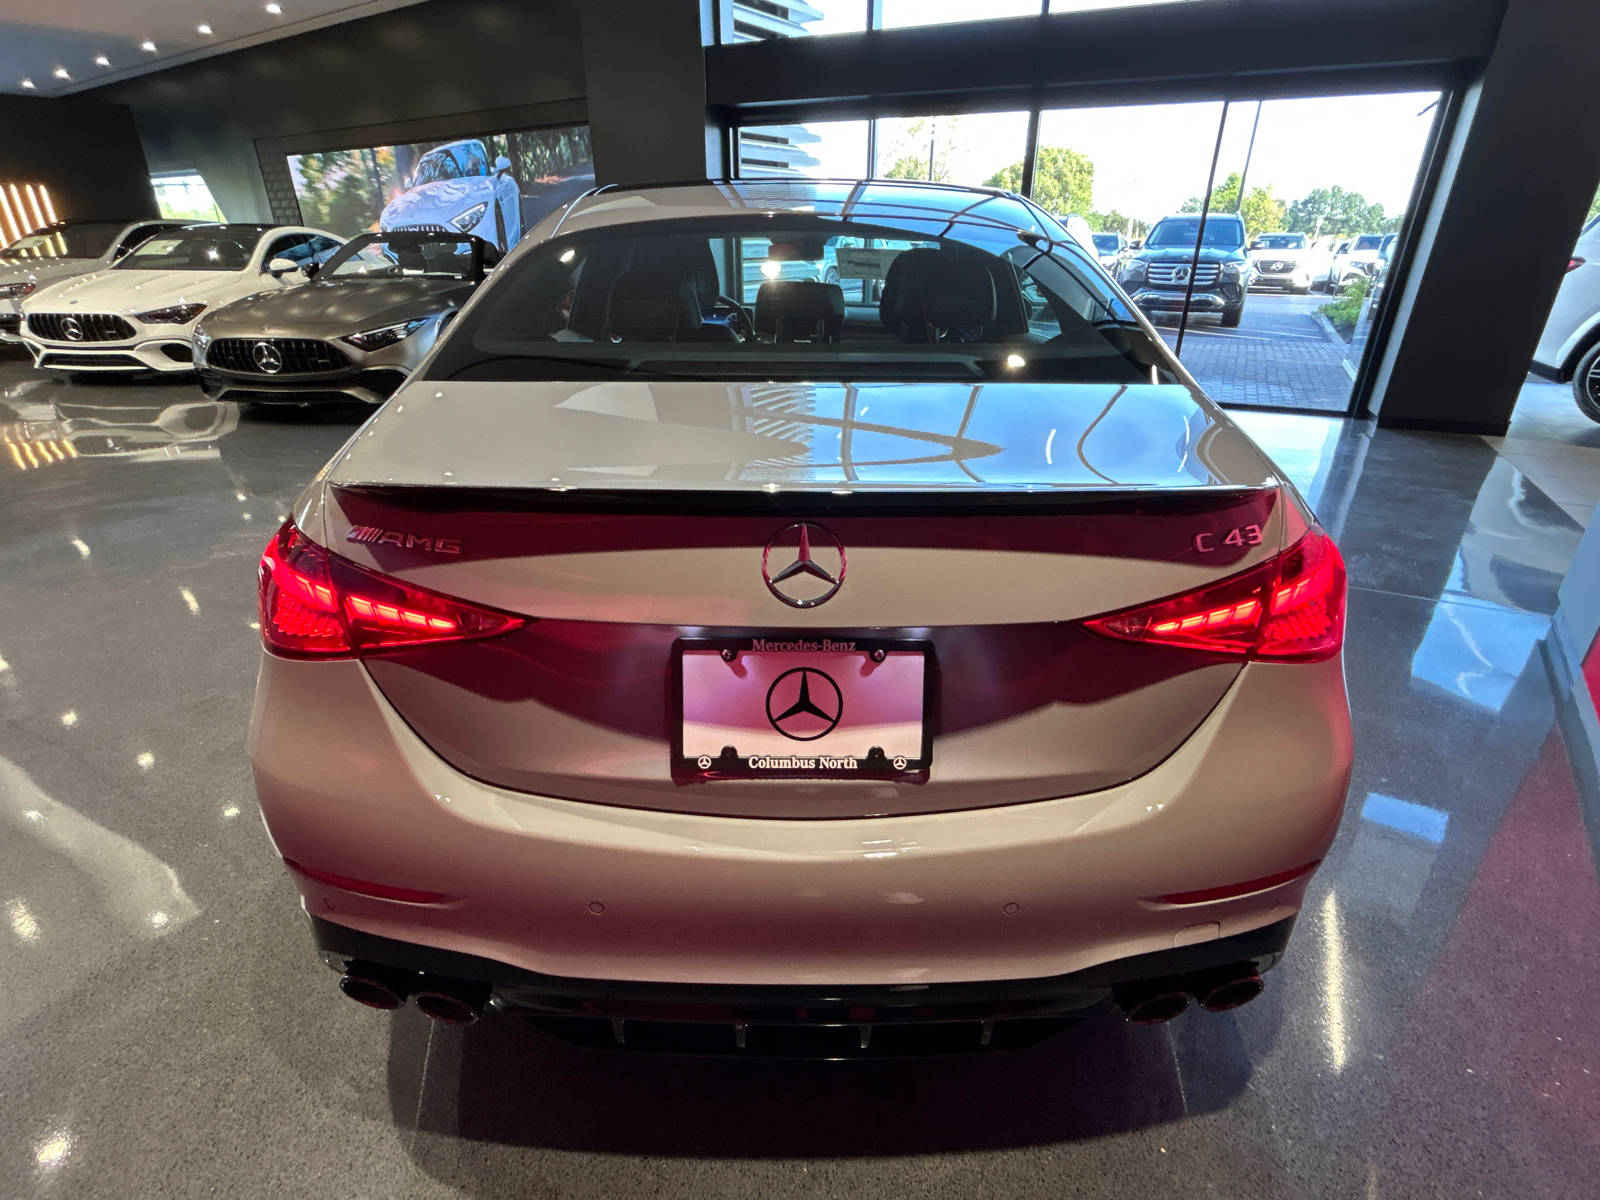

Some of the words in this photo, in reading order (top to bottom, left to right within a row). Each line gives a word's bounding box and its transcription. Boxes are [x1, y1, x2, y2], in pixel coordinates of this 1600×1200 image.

[377, 530, 463, 555] AMG
[1195, 532, 1215, 553] C
[1222, 524, 1263, 547] 43
[751, 638, 856, 653] Mercedes-Benz
[748, 756, 816, 770] Columbus
[819, 756, 858, 770] North
